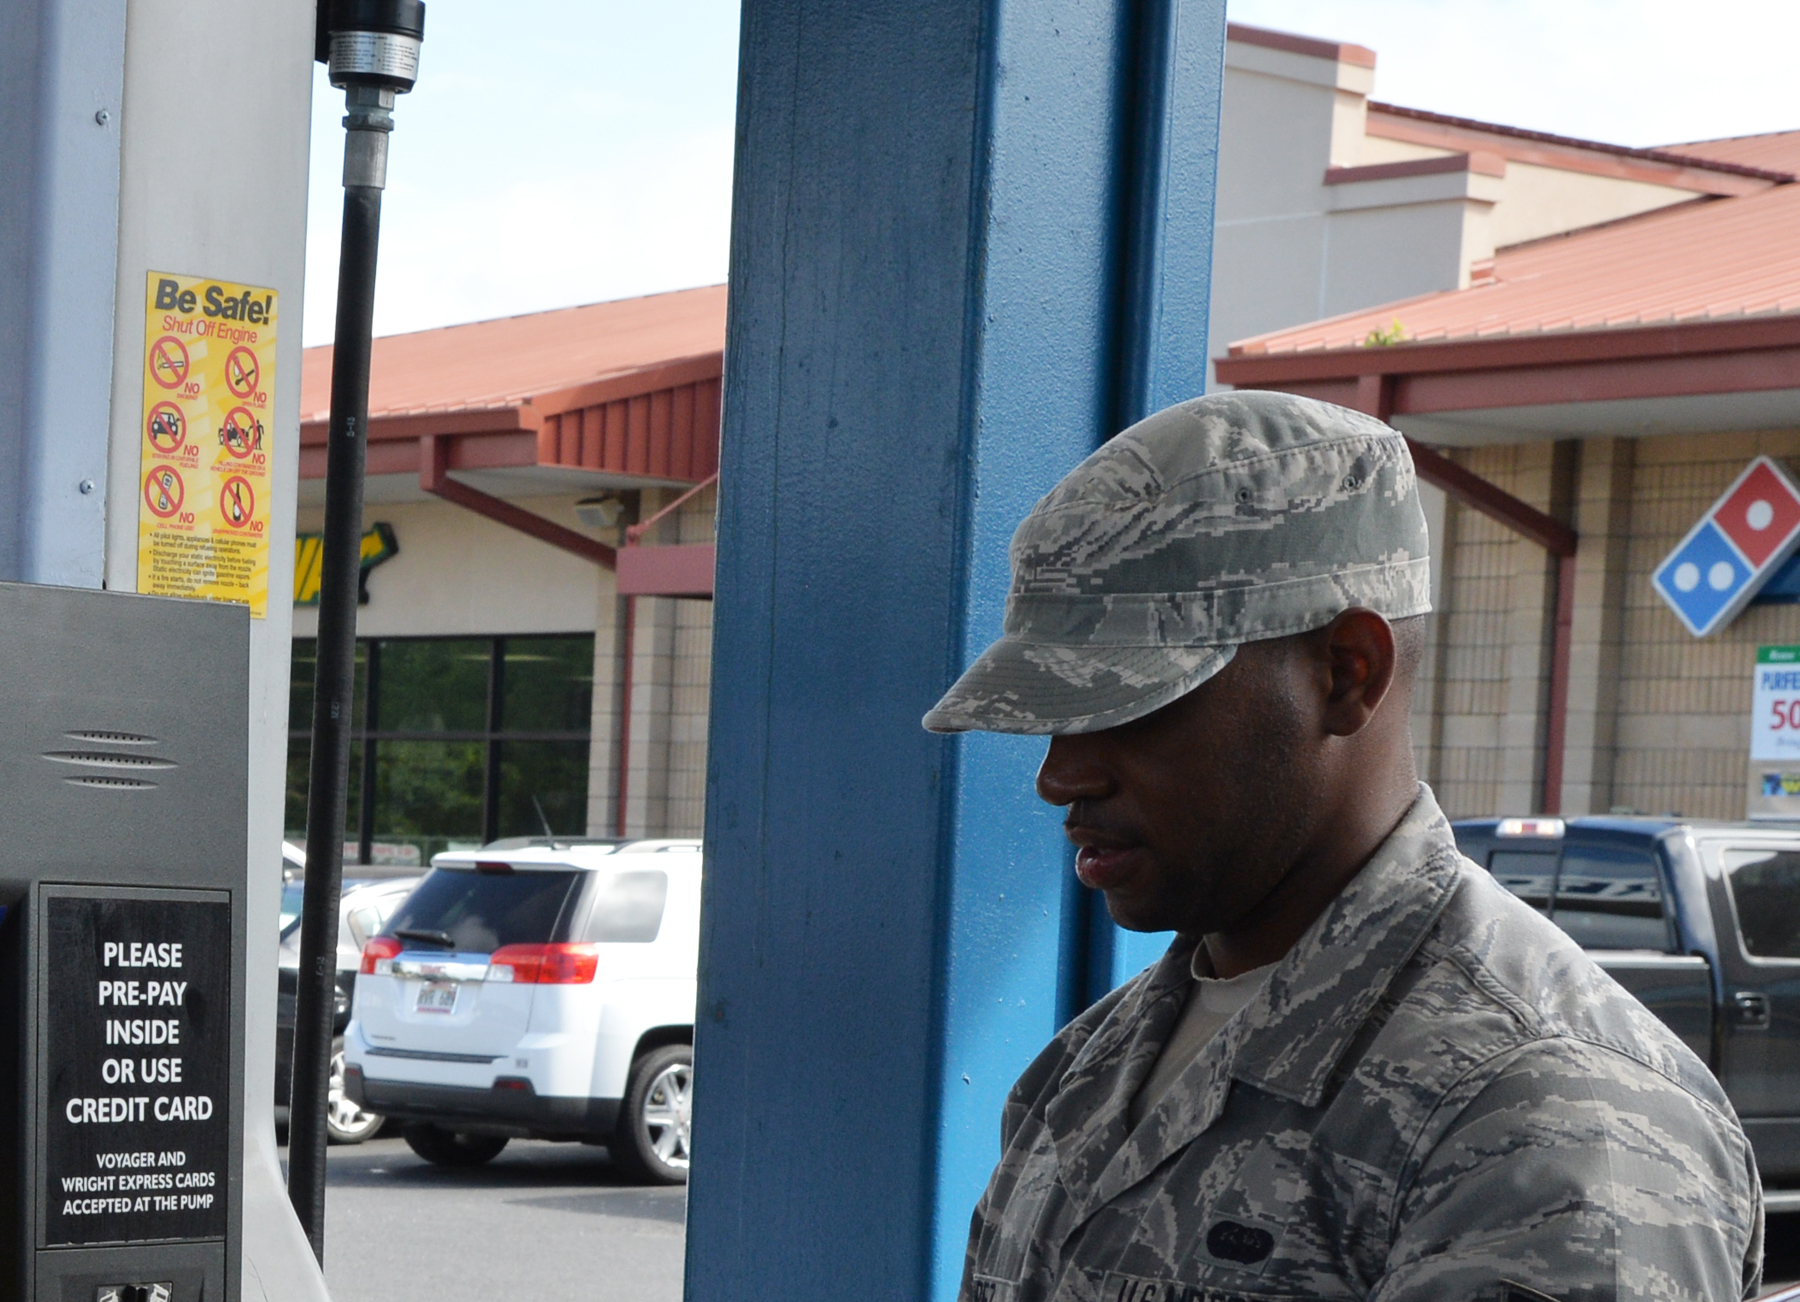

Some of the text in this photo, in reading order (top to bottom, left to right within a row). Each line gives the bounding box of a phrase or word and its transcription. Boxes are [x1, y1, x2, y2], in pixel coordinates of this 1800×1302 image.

[155, 278, 273, 325] Be Safe!
[162, 315, 258, 345] Shut Off Engine
[184, 382, 200, 395] NO
[253, 392, 267, 403] NO
[183, 445, 199, 457] NO
[252, 454, 266, 465] NO
[179, 512, 195, 524] NO
[250, 521, 264, 533] NO
[103, 942, 183, 968] PLEASE
[98, 980, 188, 1006] PRE-PAY
[105, 1019, 180, 1045] INSIDE
[101, 1057, 182, 1084] OR USE
[65, 1095, 213, 1124] CREDIT CARD
[96, 1151, 186, 1169] VOYAGER AND
[61, 1171, 216, 1193] WRIGHT EXPRESS CARDS
[62, 1193, 214, 1216] ACCEPTED AT THE PUMP
